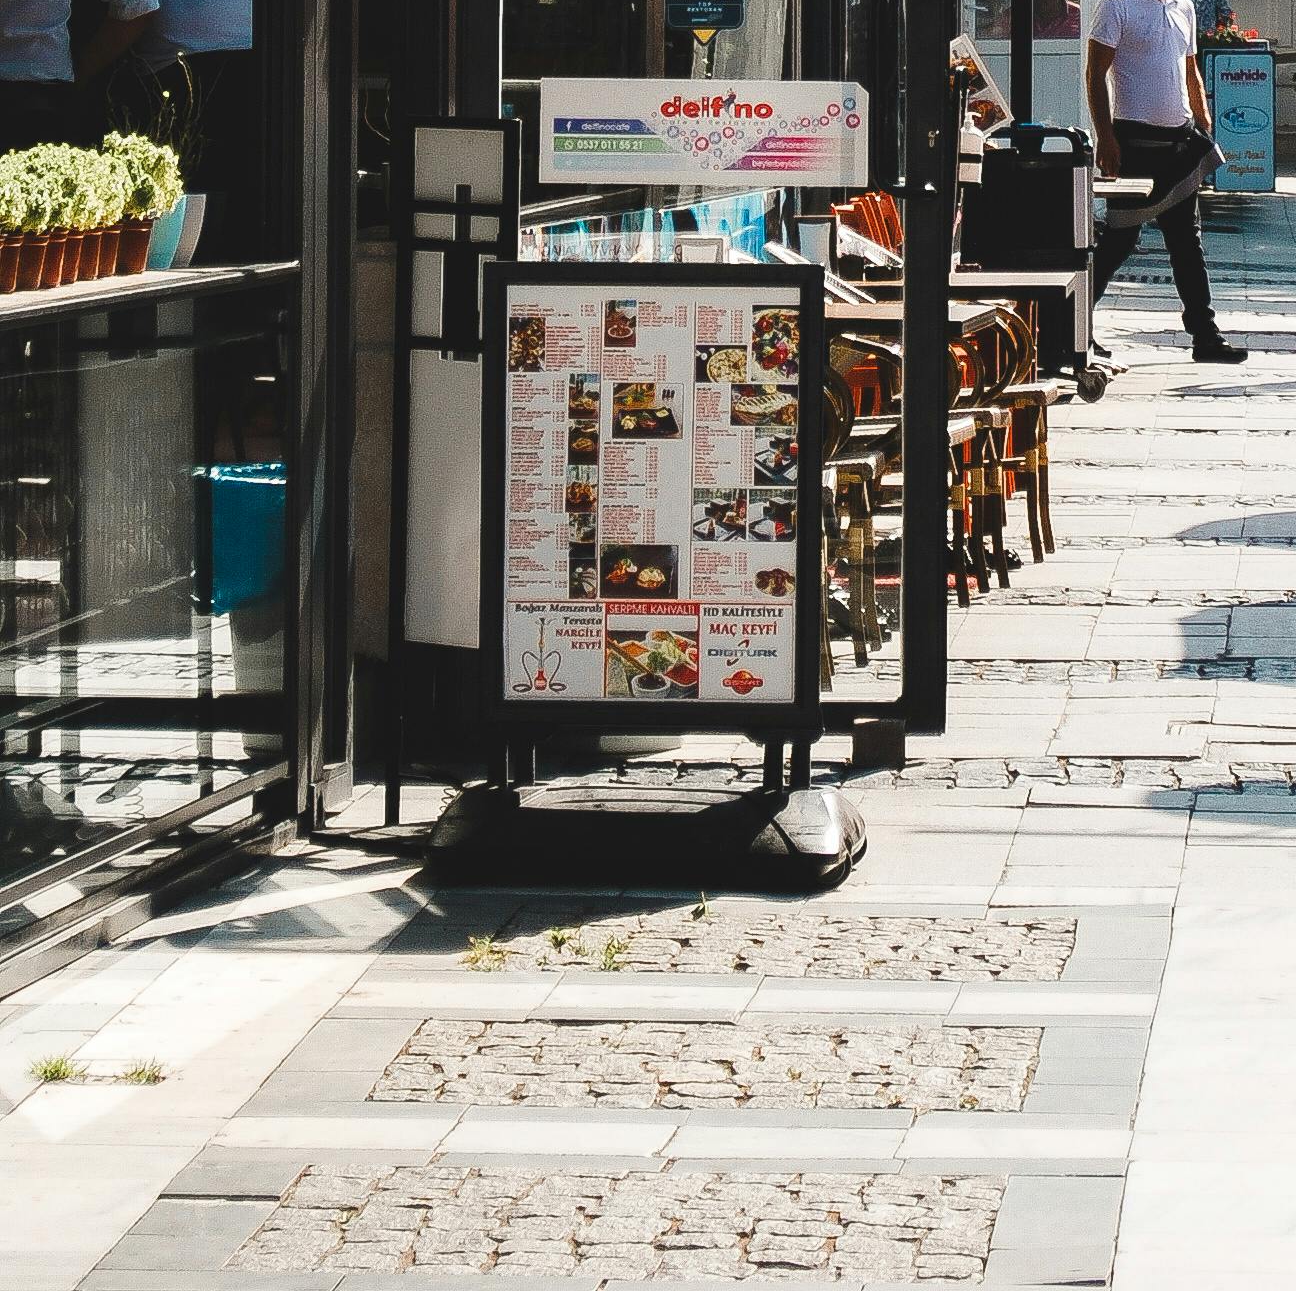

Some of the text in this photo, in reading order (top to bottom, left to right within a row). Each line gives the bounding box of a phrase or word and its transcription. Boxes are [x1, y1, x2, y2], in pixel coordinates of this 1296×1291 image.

[1220, 69, 1268, 82] mahide
[660, 90, 774, 119] delfino
[609, 603, 646, 615] SERPME
[703, 607, 718, 617] HD
[708, 621, 778, 637] MAÇ KEYFİ
